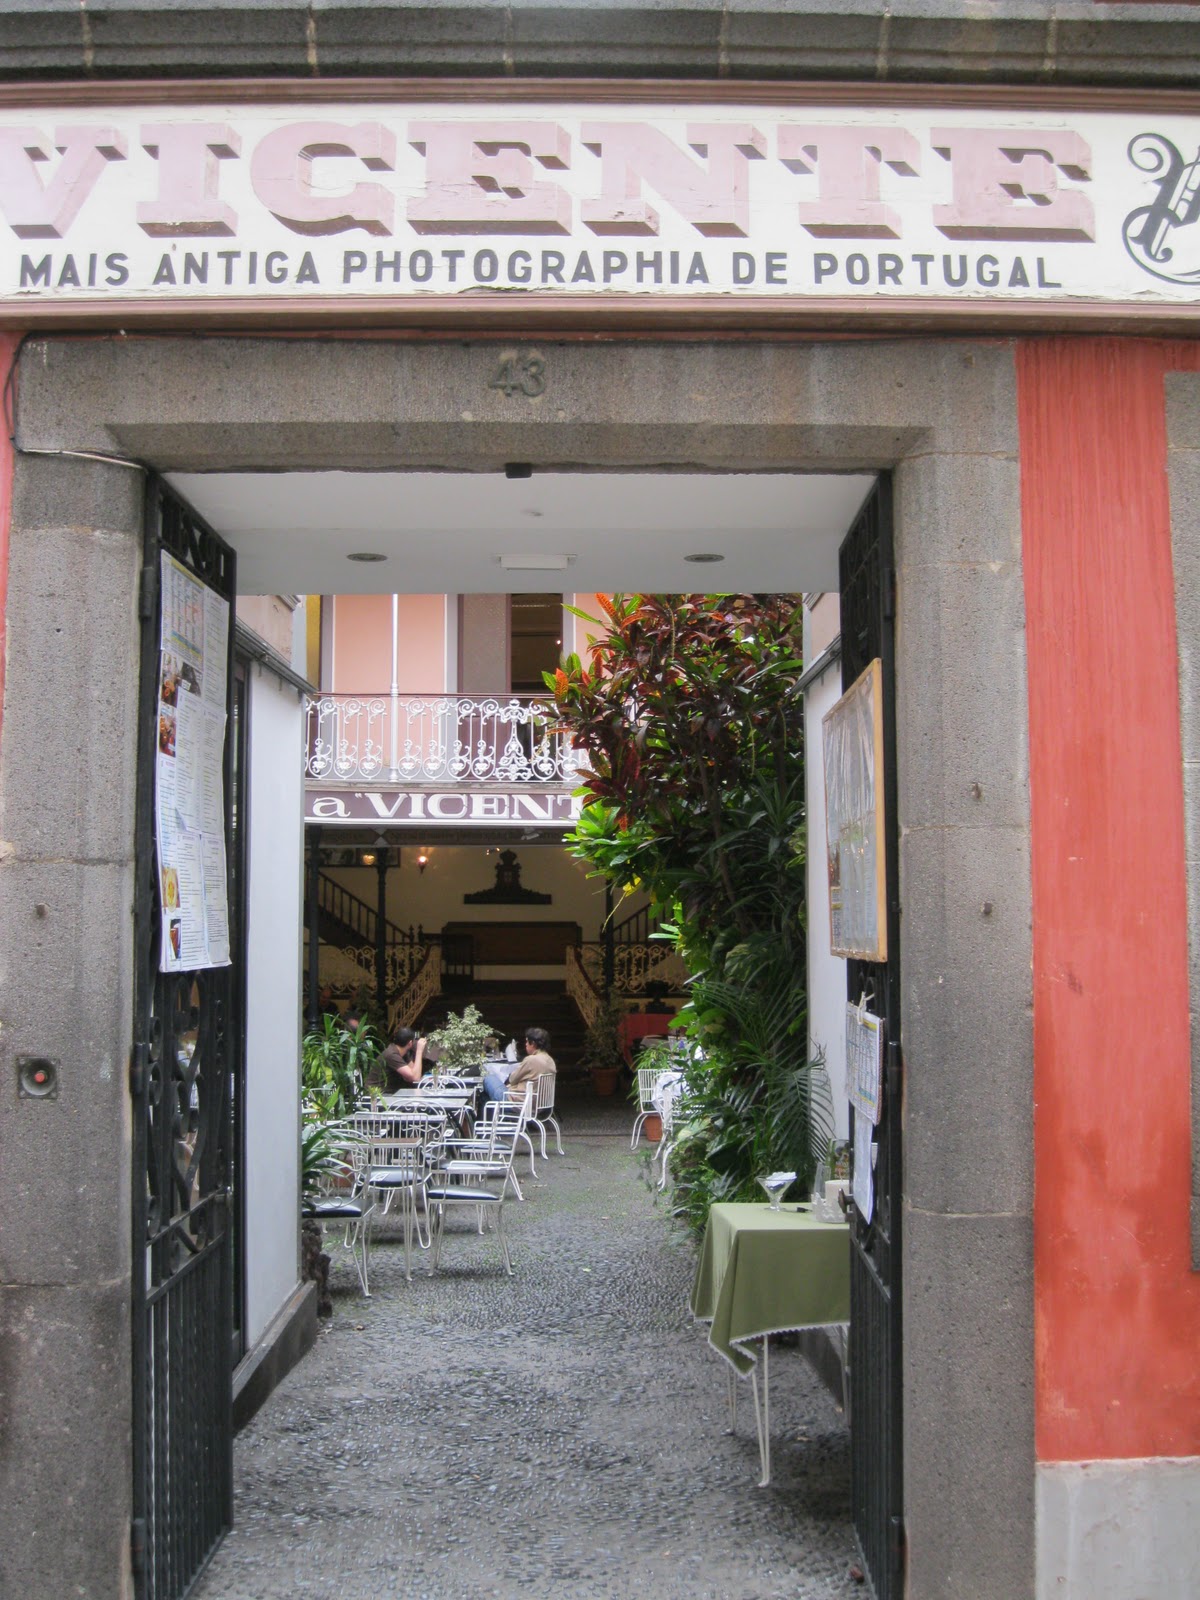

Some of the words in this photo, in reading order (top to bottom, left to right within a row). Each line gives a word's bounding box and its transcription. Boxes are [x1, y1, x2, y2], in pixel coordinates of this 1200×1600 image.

[0, 121, 1096, 243] VICENTE
[20, 252, 130, 288] MAIS
[152, 250, 321, 286] ANTIGA
[342, 248, 710, 285] PHOTOGRAPHIA
[732, 250, 789, 285] DE
[814, 252, 1063, 289] PORTUGAL
[488, 358, 546, 397] 43
[312, 796, 352, 818] a
